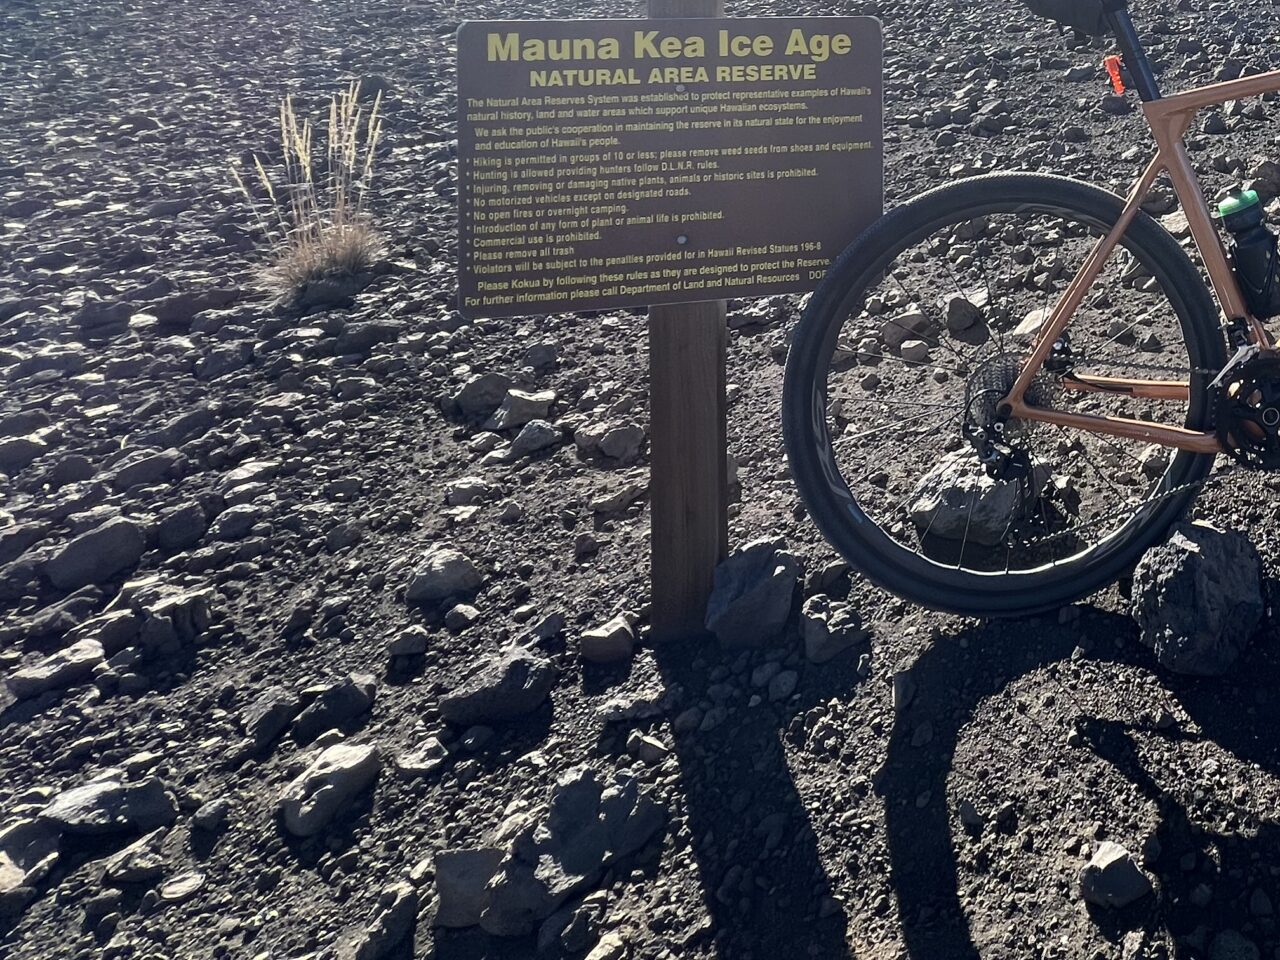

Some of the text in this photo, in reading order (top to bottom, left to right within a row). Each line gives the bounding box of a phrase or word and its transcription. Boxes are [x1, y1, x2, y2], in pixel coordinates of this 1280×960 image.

[487, 28, 852, 62] Mauna Kea Ice Age
[530, 63, 817, 87] NATURAL AREA RESERVE
[486, 97, 518, 107] Natural
[521, 96, 542, 106] Area
[544, 95, 584, 105] Reserves
[587, 94, 619, 106] System
[640, 91, 688, 102] established
[701, 91, 730, 103] protect
[732, 88, 788, 101] representative
[791, 87, 828, 100] examples
[466, 111, 498, 121] natural
[535, 109, 555, 119] land
[576, 108, 599, 118] water
[602, 109, 625, 117] areas
[628, 106, 653, 116] which
[655, 106, 687, 117] support
[690, 104, 717, 116] unique
[720, 102, 756, 113] Hawaiian
[759, 102, 809, 114] ecosystems.
[561, 122, 612, 136] cooperation
[625, 120, 674, 133] maintaining
[691, 121, 721, 129] reserve
[745, 117, 772, 127] natural
[774, 117, 793, 126] state
[822, 114, 862, 126] enjoyment
[494, 139, 537, 150] education
[473, 156, 501, 169] Hiking
[514, 154, 556, 166] permitted
[569, 154, 599, 164] groups
[659, 148, 686, 160] please
[689, 149, 718, 157] remove
[721, 145, 742, 156] weed
[744, 144, 767, 155] seeds
[769, 143, 787, 154] from
[790, 142, 813, 153] shoes
[473, 169, 507, 182] Hunting
[520, 167, 554, 178] allowed
[556, 165, 596, 178] providing
[599, 163, 630, 174] hunters
[633, 162, 658, 173] follow
[513, 180, 552, 193] removing
[567, 177, 608, 190] damaging
[611, 176, 636, 187] native
[669, 173, 700, 184] animals
[713, 171, 744, 182] historic
[746, 170, 764, 180] sites
[488, 194, 532, 206] motorized
[535, 192, 570, 204] vehicles
[573, 192, 601, 204] except
[617, 188, 662, 201] designated
[473, 221, 526, 234] Introduction
[558, 219, 578, 229] form
[591, 217, 612, 229] plant
[626, 214, 653, 225] animal
[656, 213, 669, 224] life
[488, 212, 510, 222] open
[513, 208, 532, 219] fires
[547, 205, 588, 218] overnight
[473, 235, 525, 248] Commercial
[473, 245, 574, 261] Please remove trash
[473, 262, 512, 274] Violators
[514, 261, 529, 271] will
[545, 258, 576, 271] subject
[605, 253, 643, 266] penalties
[646, 250, 681, 264] provided
[707, 247, 733, 258] Hawaii
[736, 244, 766, 256] Revised
[477, 280, 508, 291] Please
[511, 277, 540, 289] Kokua
[556, 273, 596, 287] following
[599, 271, 623, 282] these
[626, 269, 648, 280] rules
[662, 267, 681, 280] they
[699, 263, 738, 276] designed
[750, 261, 779, 273] protect
[464, 296, 480, 306] For
[482, 293, 513, 305] further
[516, 289, 567, 302] information
[570, 286, 599, 300] please
[601, 285, 617, 296] call
[619, 281, 670, 295] Department
[683, 278, 704, 290] Land
[724, 275, 754, 287] Natural
[756, 271, 799, 284] Resources
